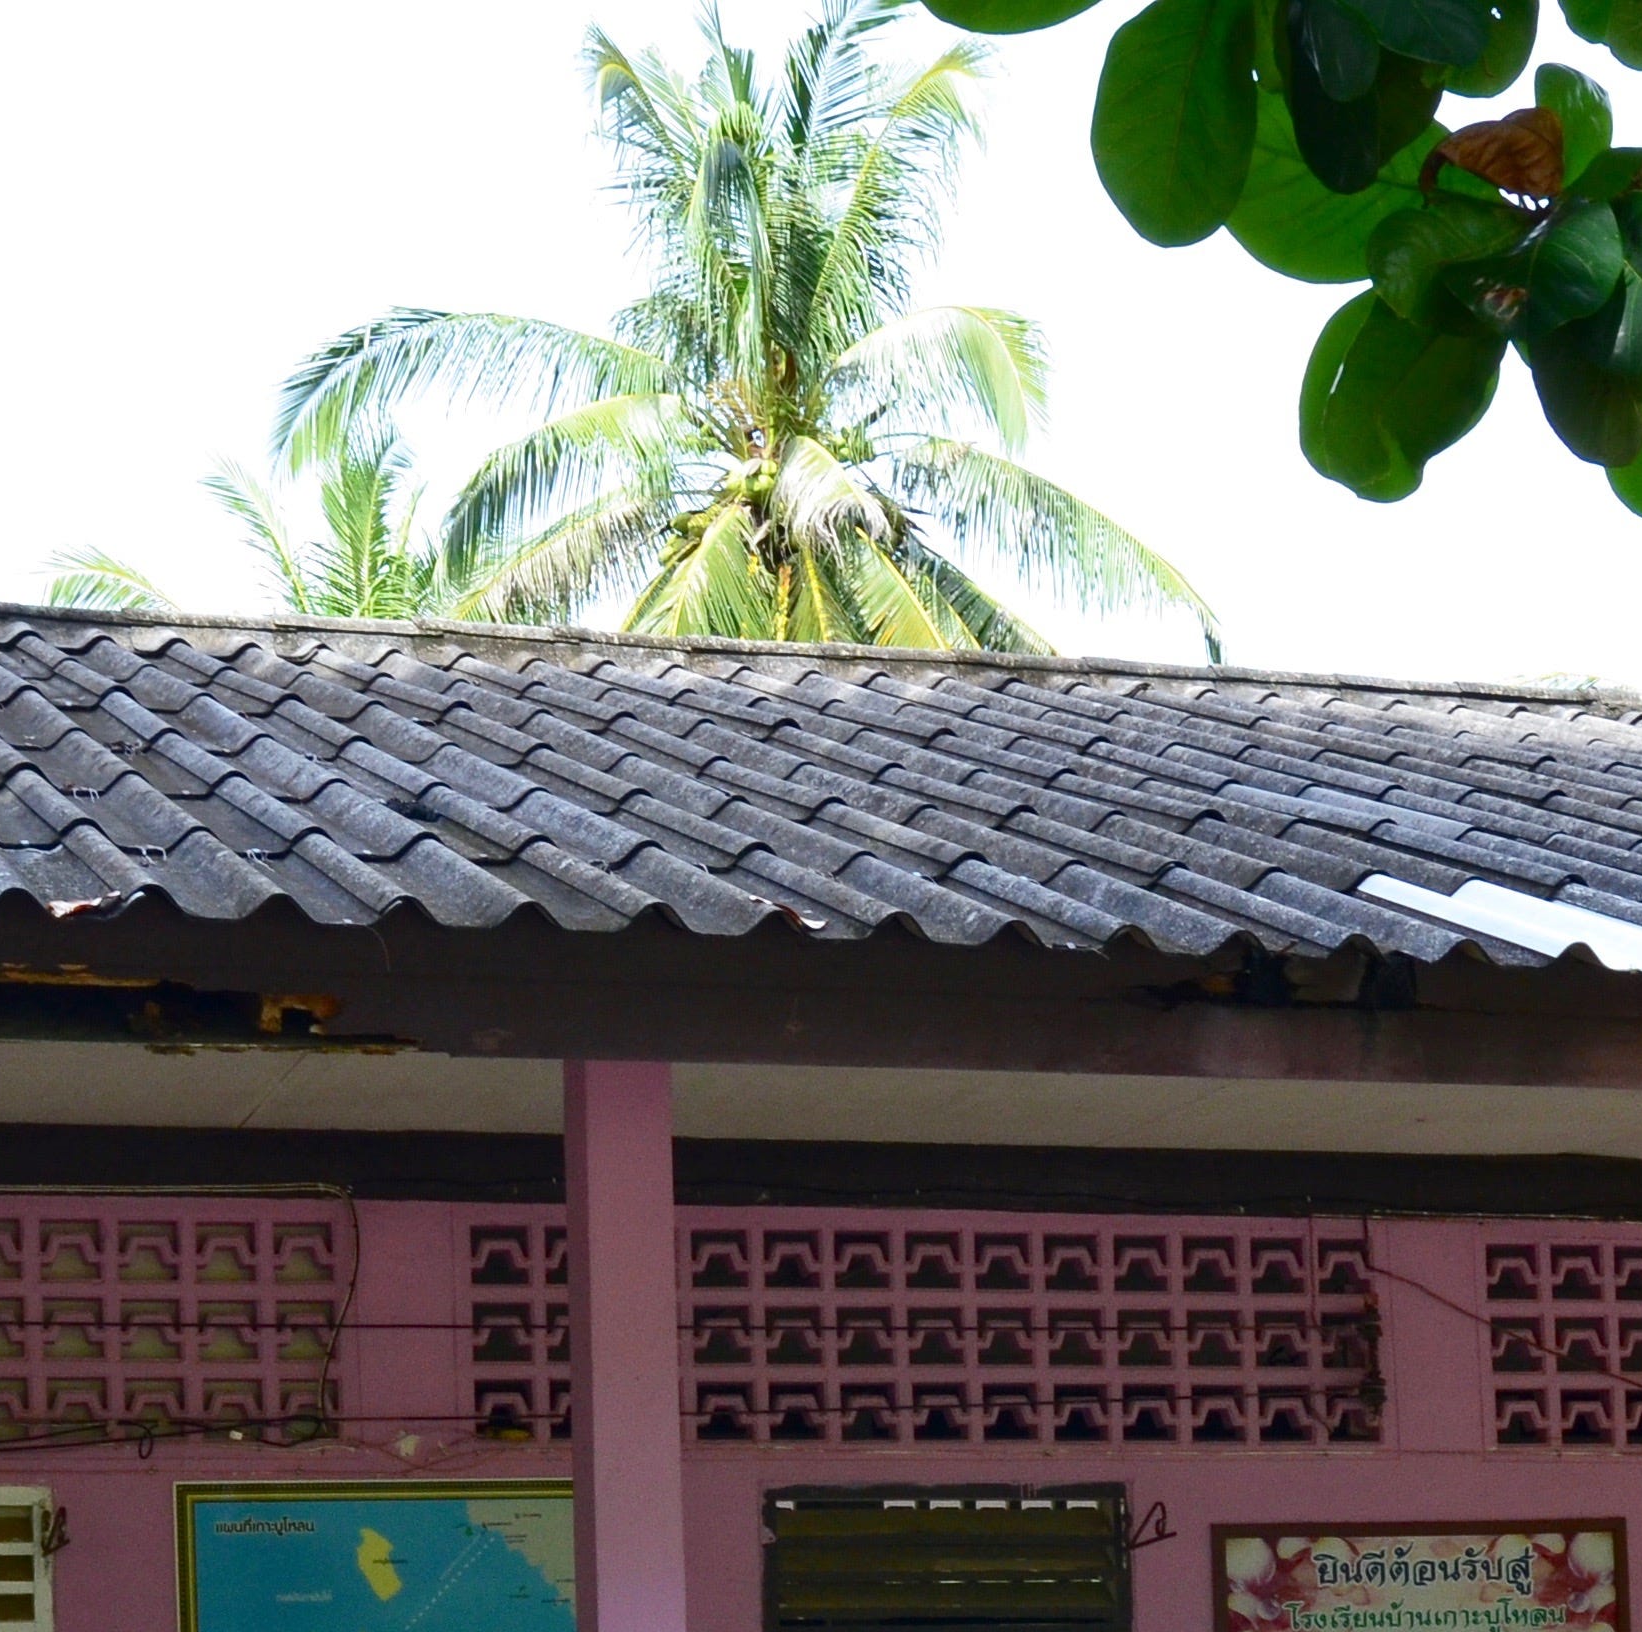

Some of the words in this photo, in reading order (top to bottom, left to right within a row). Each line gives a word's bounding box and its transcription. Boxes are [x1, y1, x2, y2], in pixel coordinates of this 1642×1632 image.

[1314, 1543, 1535, 1595] ยินดีต้อนรับสู่
